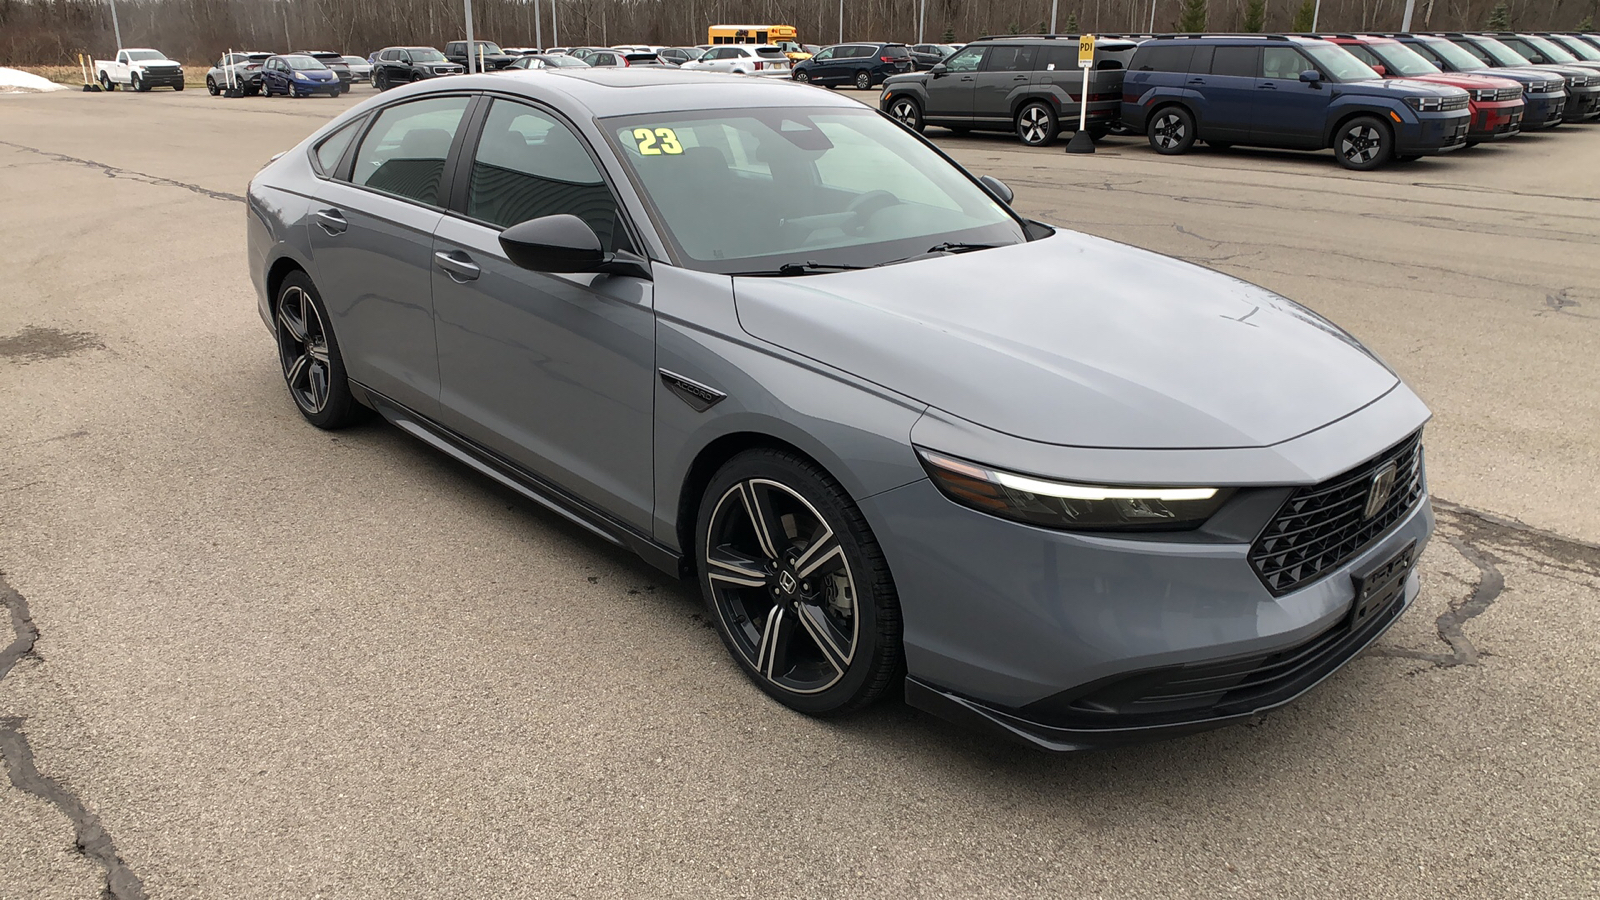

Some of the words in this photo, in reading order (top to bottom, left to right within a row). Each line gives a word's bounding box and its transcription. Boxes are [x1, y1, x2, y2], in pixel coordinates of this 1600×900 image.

[1080, 43, 1093, 51] PDI
[633, 128, 683, 155] 23
[675, 381, 712, 400] ACCORD
